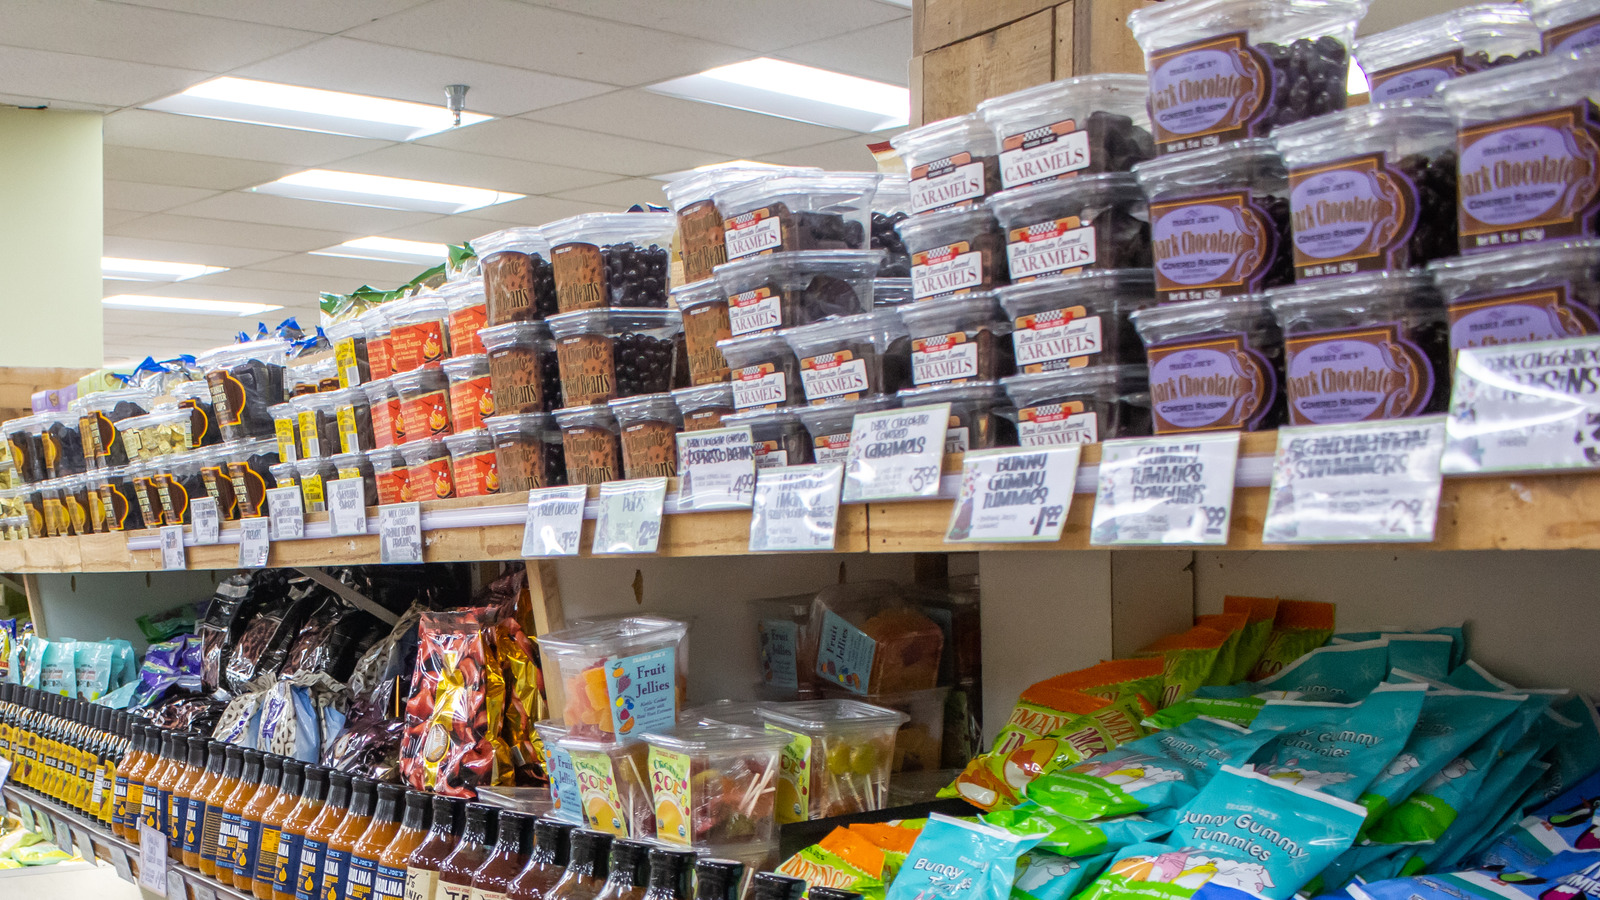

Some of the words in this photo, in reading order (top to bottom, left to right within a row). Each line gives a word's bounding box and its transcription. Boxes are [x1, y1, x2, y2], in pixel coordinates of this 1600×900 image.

[1179, 74, 1241, 103] Chocolate
[1005, 148, 1084, 182] CARAMELS
[1493, 155, 1574, 189] Chocolate
[912, 178, 980, 209] CARAMELS
[1316, 196, 1380, 226] Chocolate
[1181, 229, 1242, 255] Chocolate
[703, 243, 727, 270] Bean
[1011, 245, 1089, 275] CARAMELS
[573, 282, 600, 304] Beans
[732, 311, 777, 333] ARAMELS
[1017, 335, 1096, 361] CARAMELS
[580, 373, 611, 396] Beans
[806, 377, 863, 397] CARAMELS
[1179, 373, 1241, 398] Chocolate
[1321, 366, 1392, 394] Chocolate
[509, 384, 537, 406] Beans
[585, 466, 613, 484] Beans
[646, 461, 675, 478] Beans
[771, 629, 789, 641] Fruit
[826, 625, 838, 654] Fruit
[836, 627, 849, 663] Jellies
[637, 663, 666, 679] Fruit
[636, 681, 670, 699] Jellies
[1161, 736, 1200, 754] Bunny
[557, 755, 573, 770] Fruit
[558, 771, 577, 786] Jellies
[1193, 826, 1272, 862] Tummies
[1234, 814, 1310, 859] Gummy
[348, 867, 371, 886] OLINA
[388, 869, 405, 877] JOE'S
[913, 858, 965, 880] Bunny
